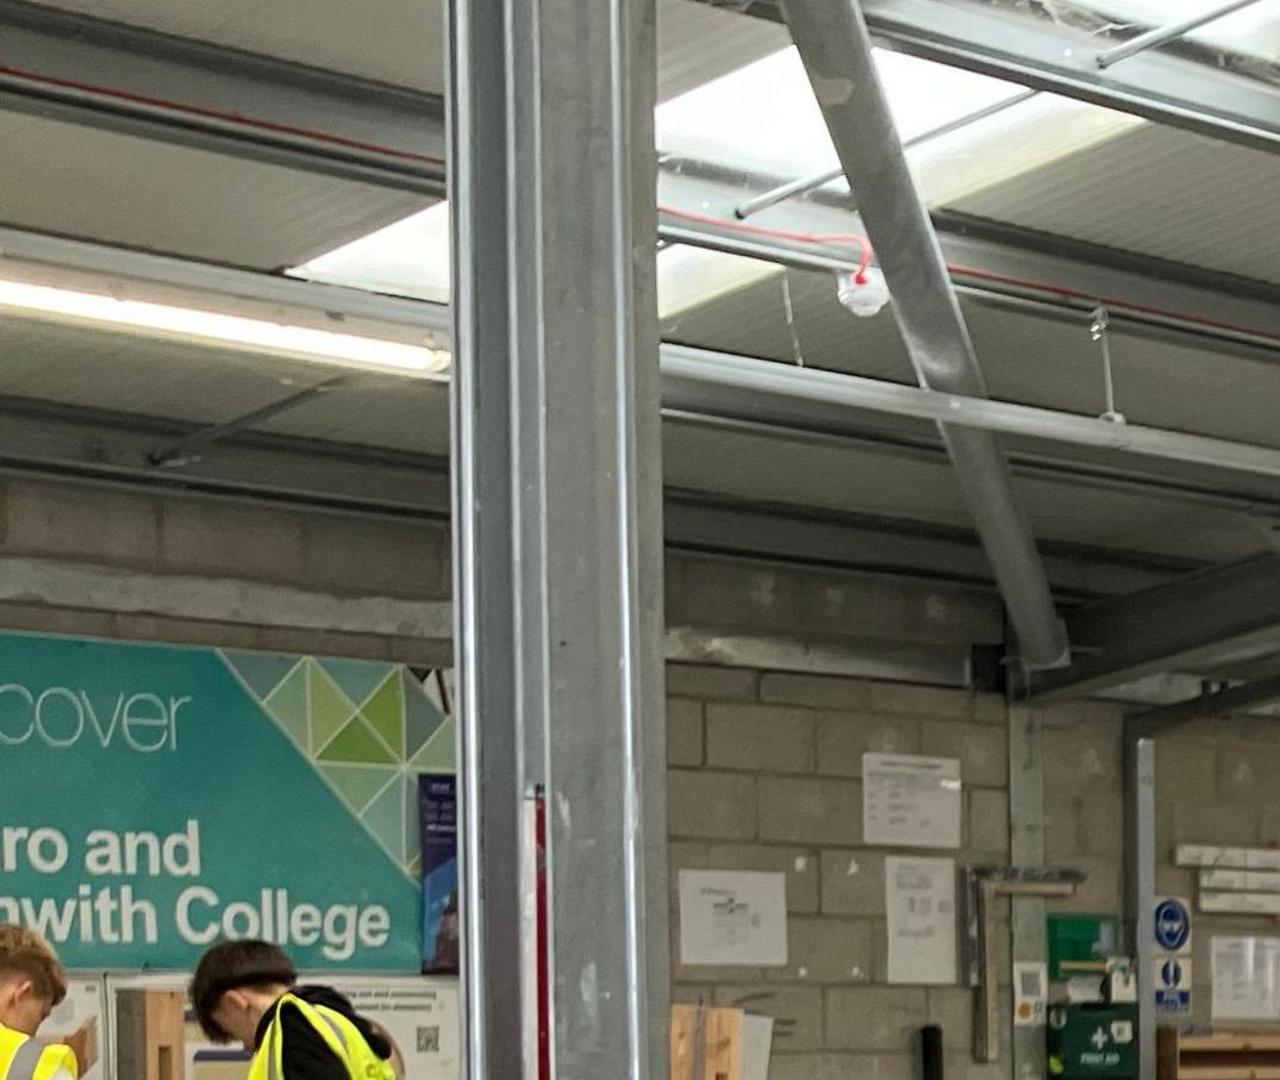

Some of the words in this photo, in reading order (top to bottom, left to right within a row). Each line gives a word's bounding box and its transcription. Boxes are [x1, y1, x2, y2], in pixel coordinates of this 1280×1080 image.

[3, 826, 69, 874] ro
[85, 819, 200, 876] and
[175, 886, 391, 961] College
